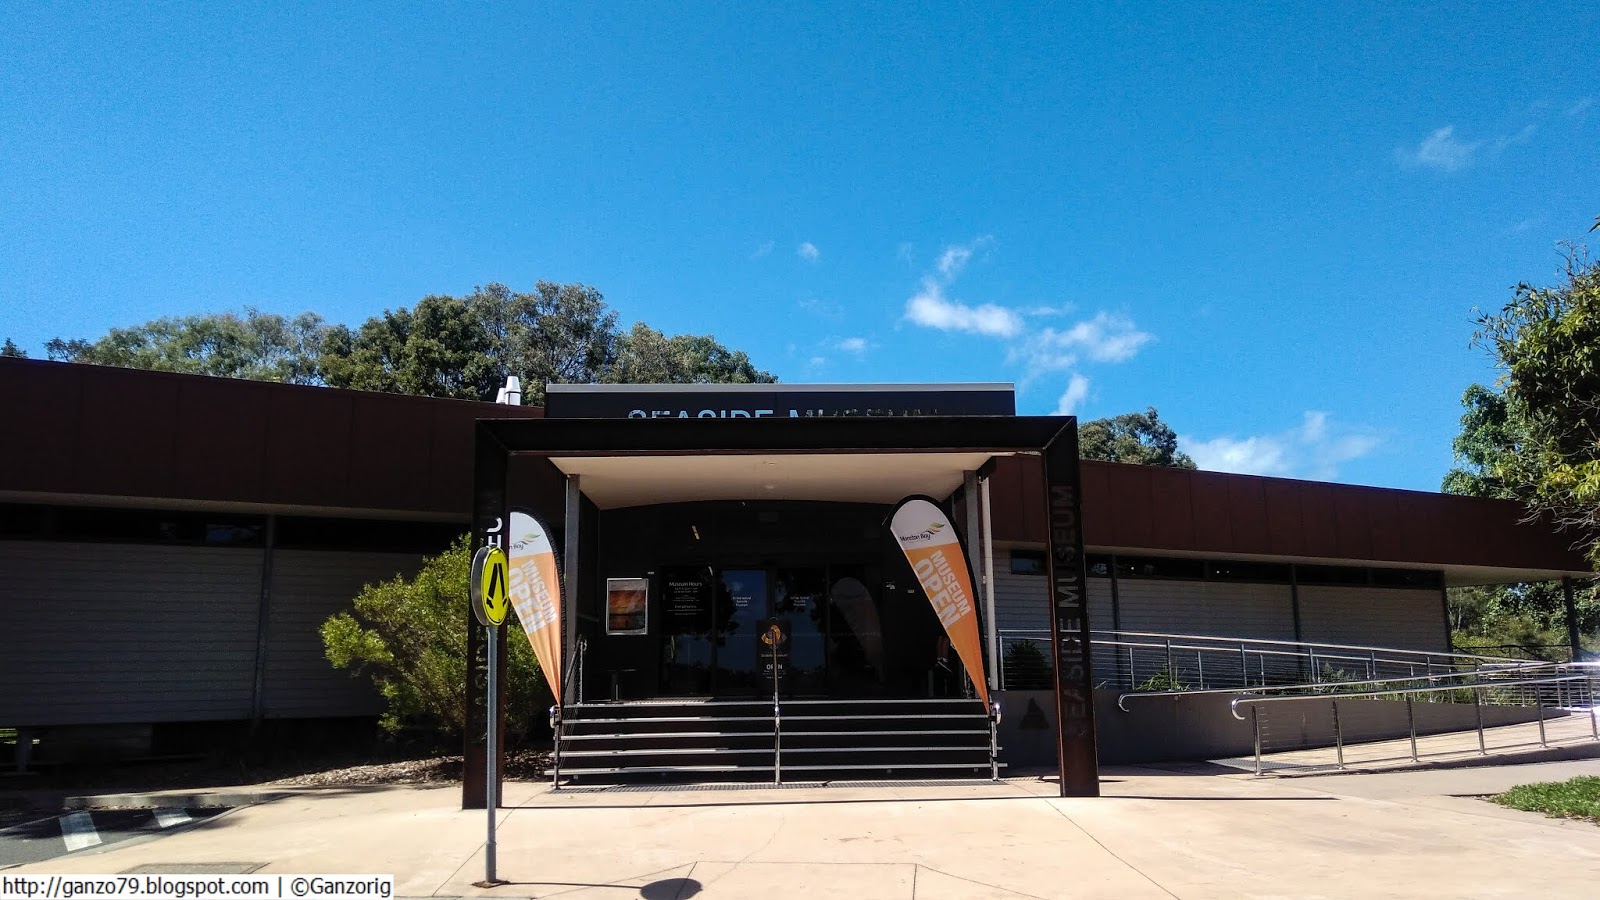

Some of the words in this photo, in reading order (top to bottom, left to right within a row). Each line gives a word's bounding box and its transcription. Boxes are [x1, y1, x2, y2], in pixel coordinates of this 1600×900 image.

[899, 534, 919, 542] Moreton
[920, 533, 931, 541] Bay
[508, 567, 546, 635] OPEN
[521, 559, 558, 623] MUSEUM
[914, 558, 962, 629] OPEN
[931, 549, 971, 617] MUSEUM
[1058, 617, 1087, 736] EASIDE
